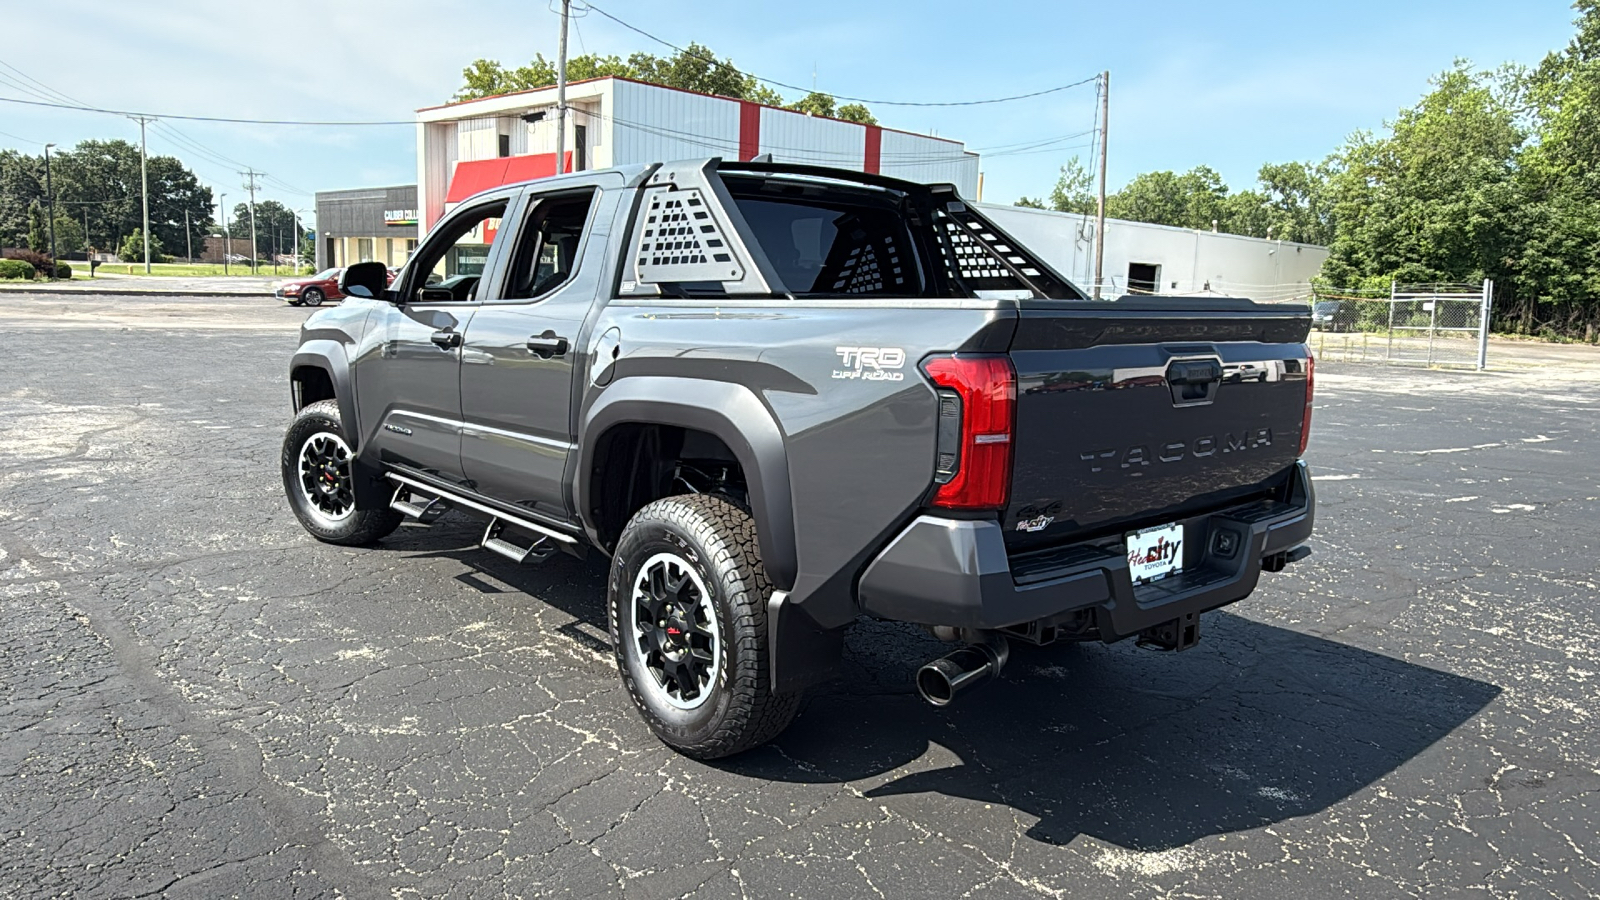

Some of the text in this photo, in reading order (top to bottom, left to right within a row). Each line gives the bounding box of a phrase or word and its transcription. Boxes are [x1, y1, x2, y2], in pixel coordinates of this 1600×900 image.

[835, 346, 906, 370] TRD
[831, 369, 904, 381] OFF ROAD
[1080, 427, 1272, 473] TACOMA
[1144, 560, 1167, 570] TOYOTA
